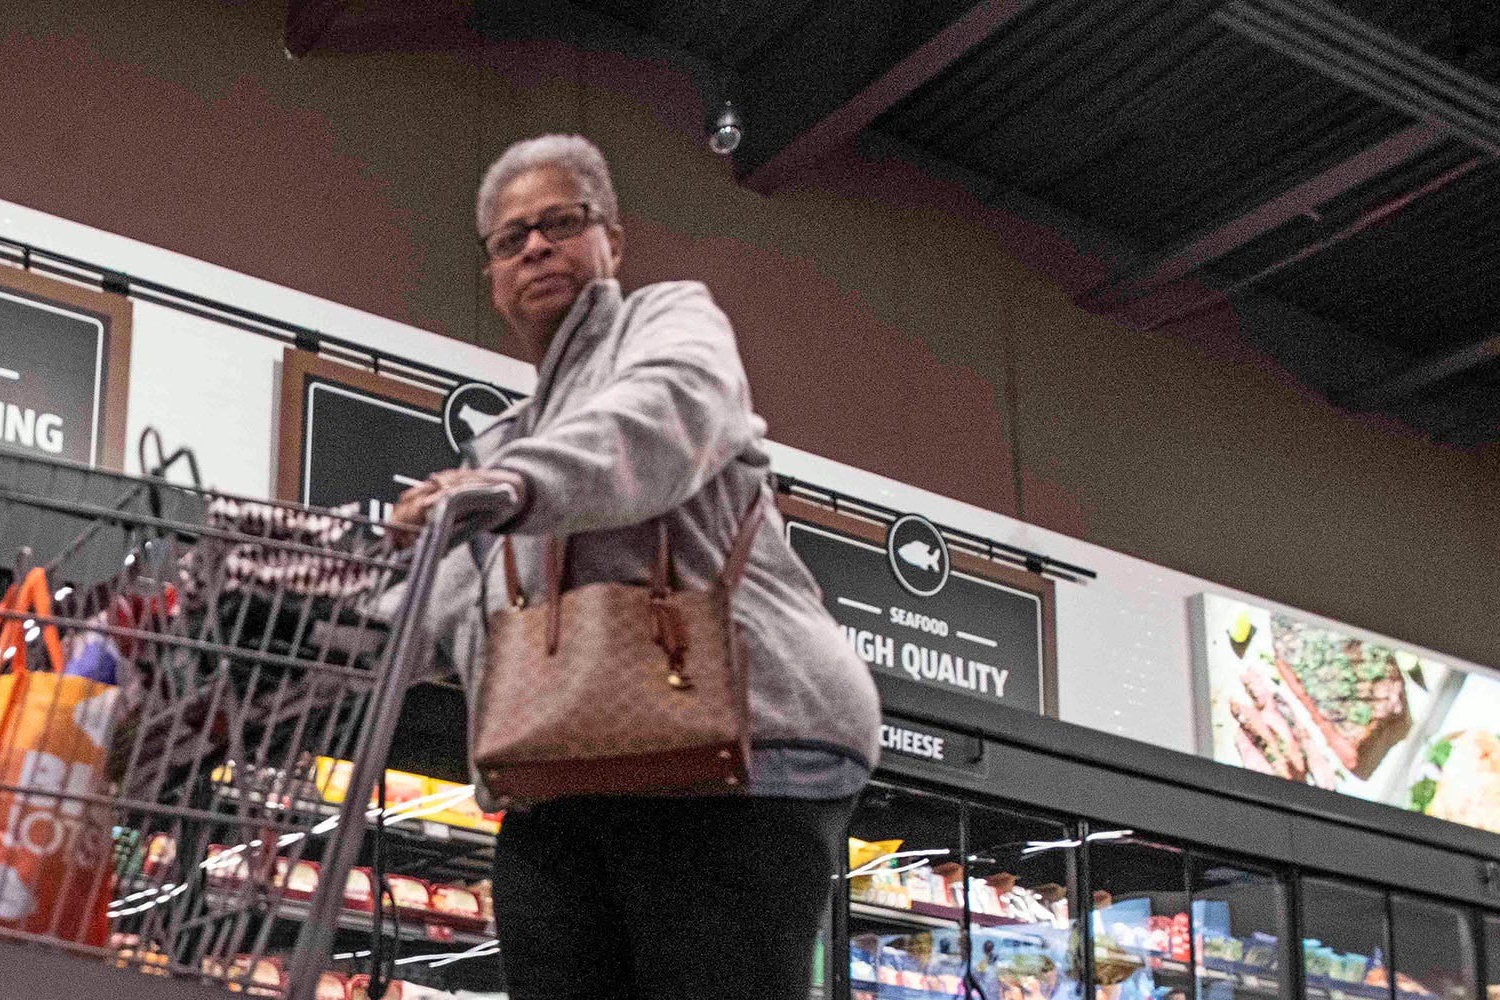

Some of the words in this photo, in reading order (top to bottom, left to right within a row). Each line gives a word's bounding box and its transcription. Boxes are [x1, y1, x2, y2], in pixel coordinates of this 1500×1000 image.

[889, 606, 949, 638] SEAFOOD
[838, 624, 895, 668] IGH
[901, 642, 1010, 698] QUALITY
[878, 723, 945, 761] CHEESE
